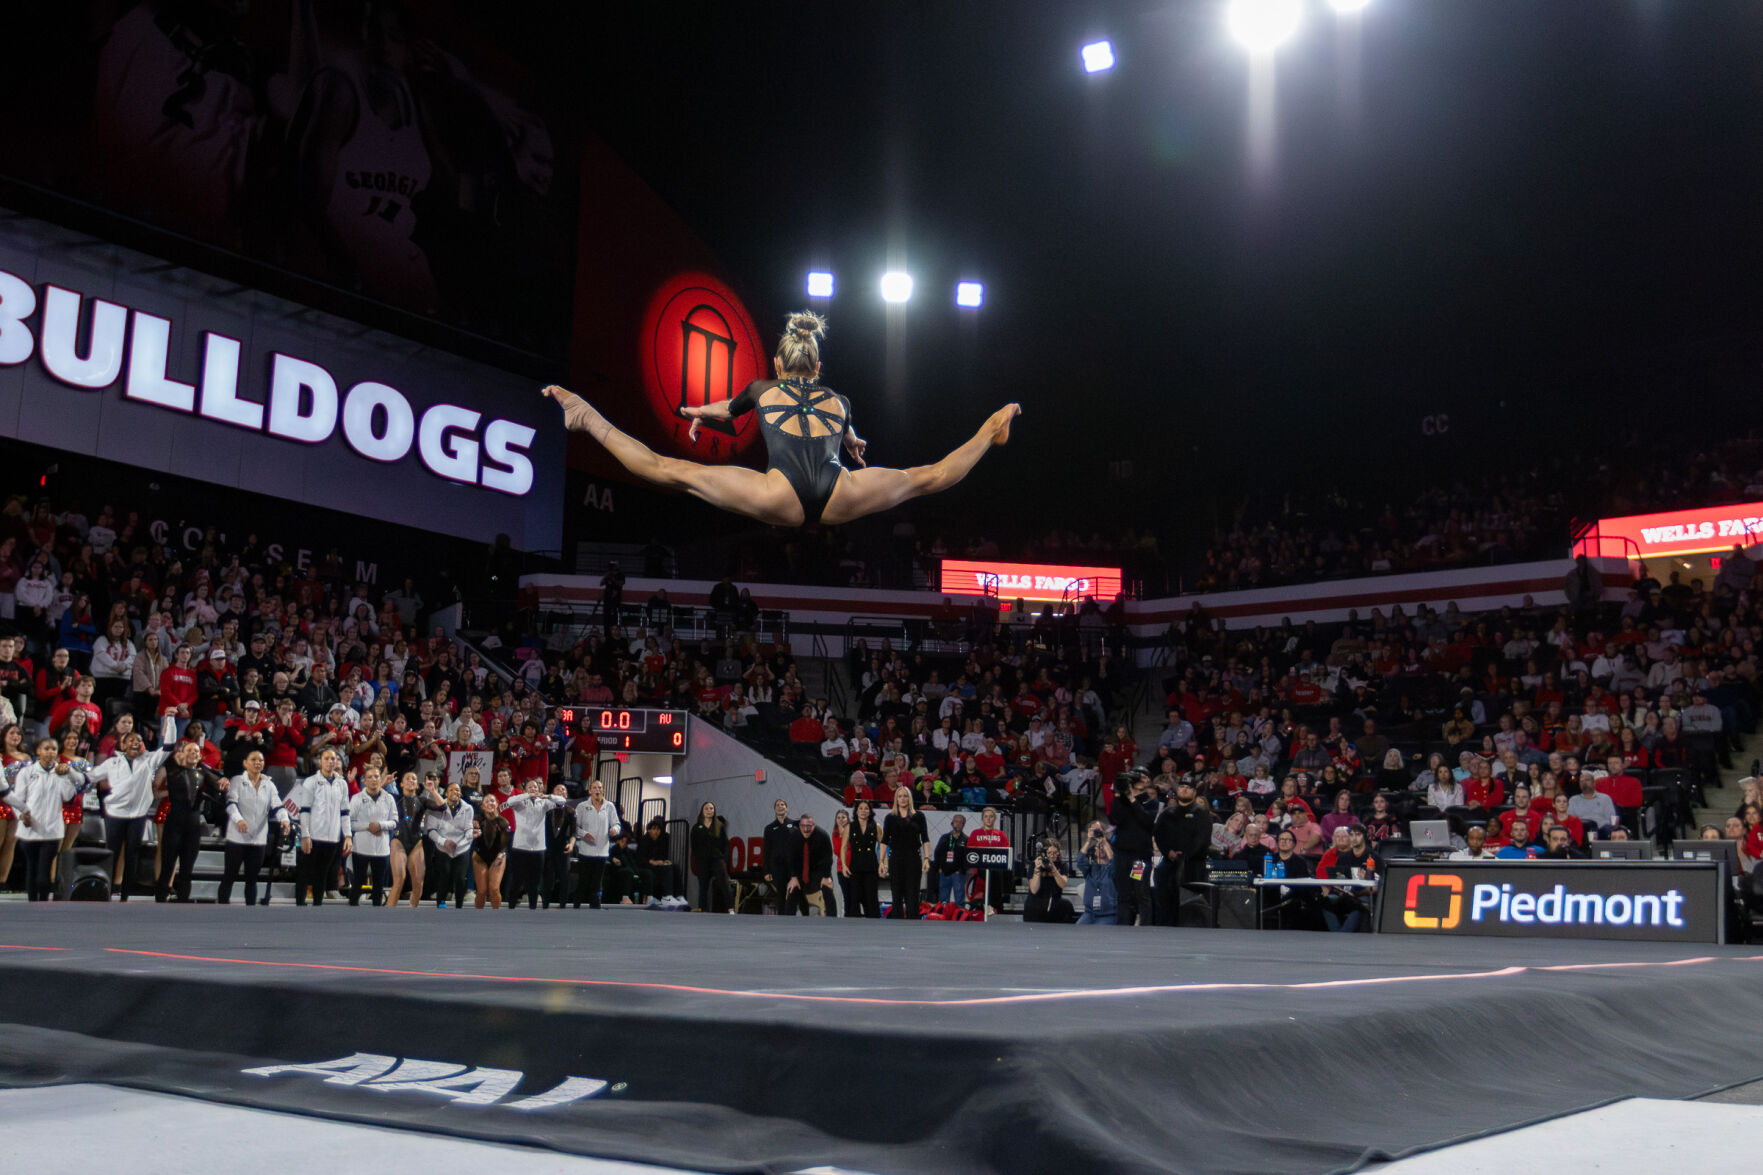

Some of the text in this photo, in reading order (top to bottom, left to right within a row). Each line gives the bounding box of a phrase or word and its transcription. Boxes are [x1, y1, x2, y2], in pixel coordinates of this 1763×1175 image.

[583, 483, 615, 512] AA
[1641, 522, 1715, 544] WELLS
[975, 573, 1090, 592] WELLS FARGO
[601, 711, 631, 729] 0.0
[659, 713, 672, 725] AU
[625, 735, 630, 748] 1
[673, 732, 683, 746] 0
[982, 853, 1007, 864] FLOOR
[1471, 883, 1685, 927] Piedmont
